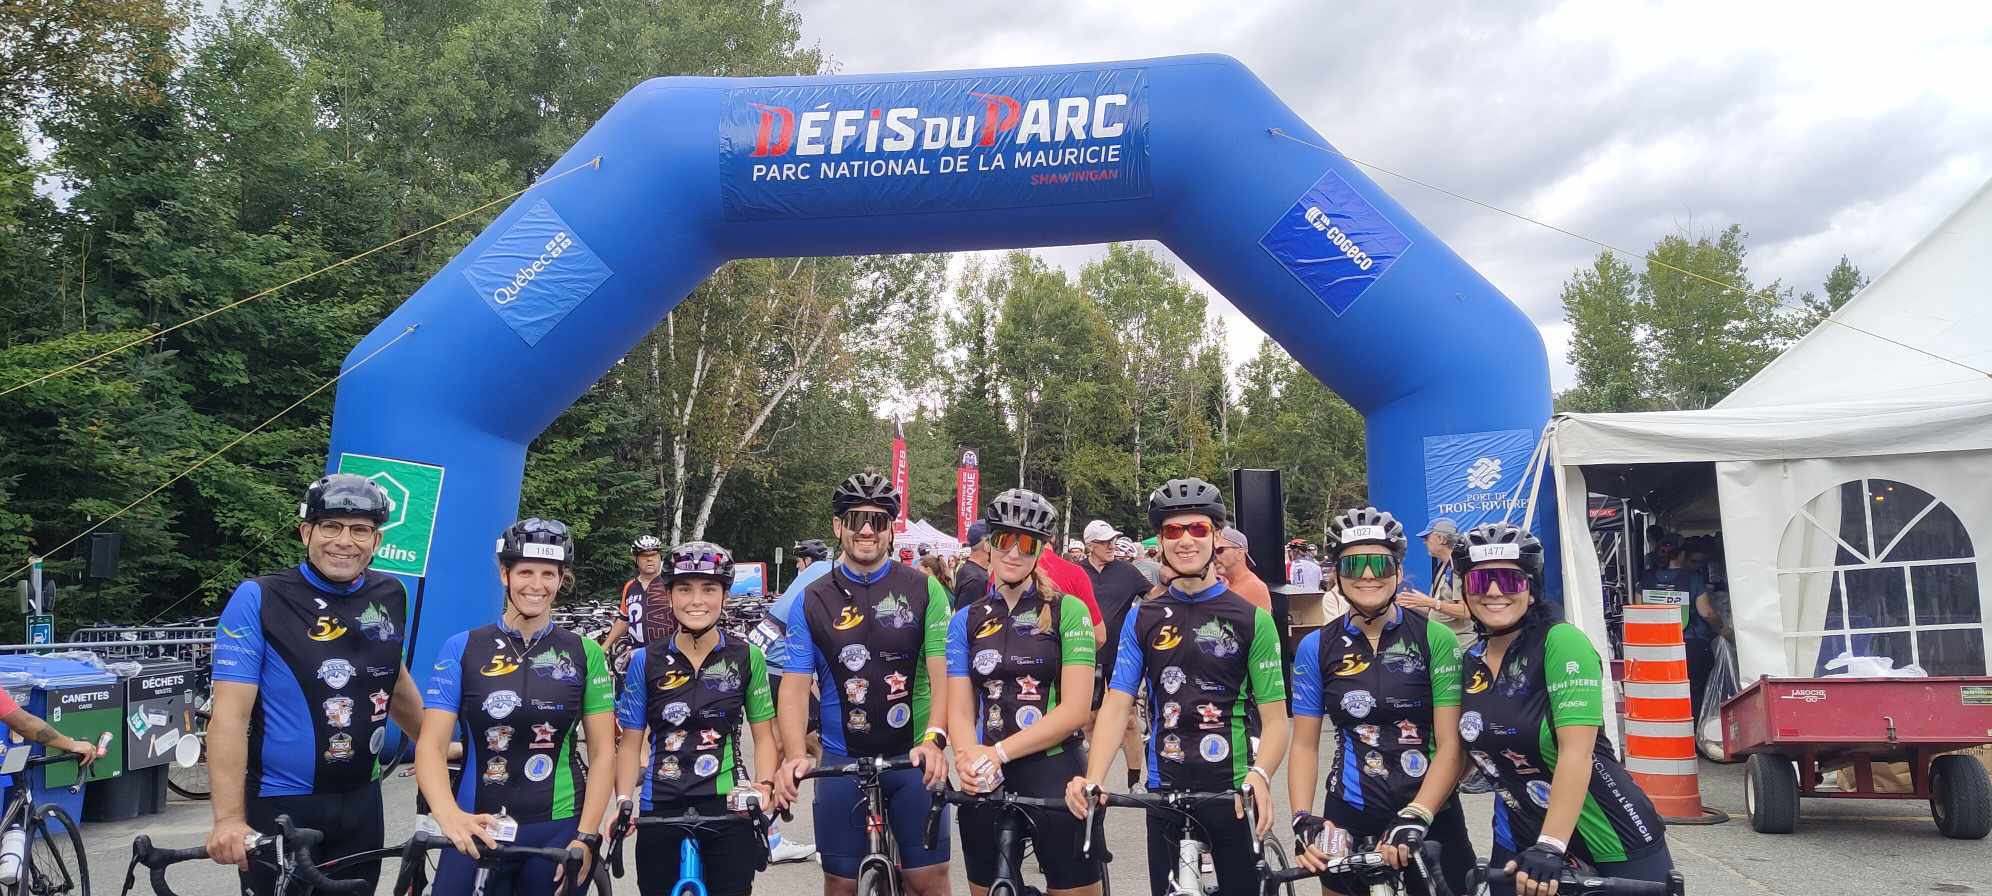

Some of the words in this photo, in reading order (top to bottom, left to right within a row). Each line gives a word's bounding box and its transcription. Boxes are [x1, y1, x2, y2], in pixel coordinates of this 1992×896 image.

[922, 115, 975, 150] DU
[967, 92, 1128, 148] PARC
[752, 163, 811, 182] PARC
[819, 158, 930, 180] NATIONAL
[940, 155, 969, 173] DE
[978, 153, 1006, 171] LA
[1014, 144, 1122, 169] MAURICIE
[1030, 169, 1120, 186] SHAWINIGAN
[494, 253, 552, 305] Québec
[1467, 493, 1491, 502] PORT
[1353, 528, 1371, 536] 1027
[378, 544, 416, 561] dins
[1483, 546, 1504, 557] 1477
[142, 675, 184, 690] DÉCHETS
[61, 690, 110, 704] CANETTES
